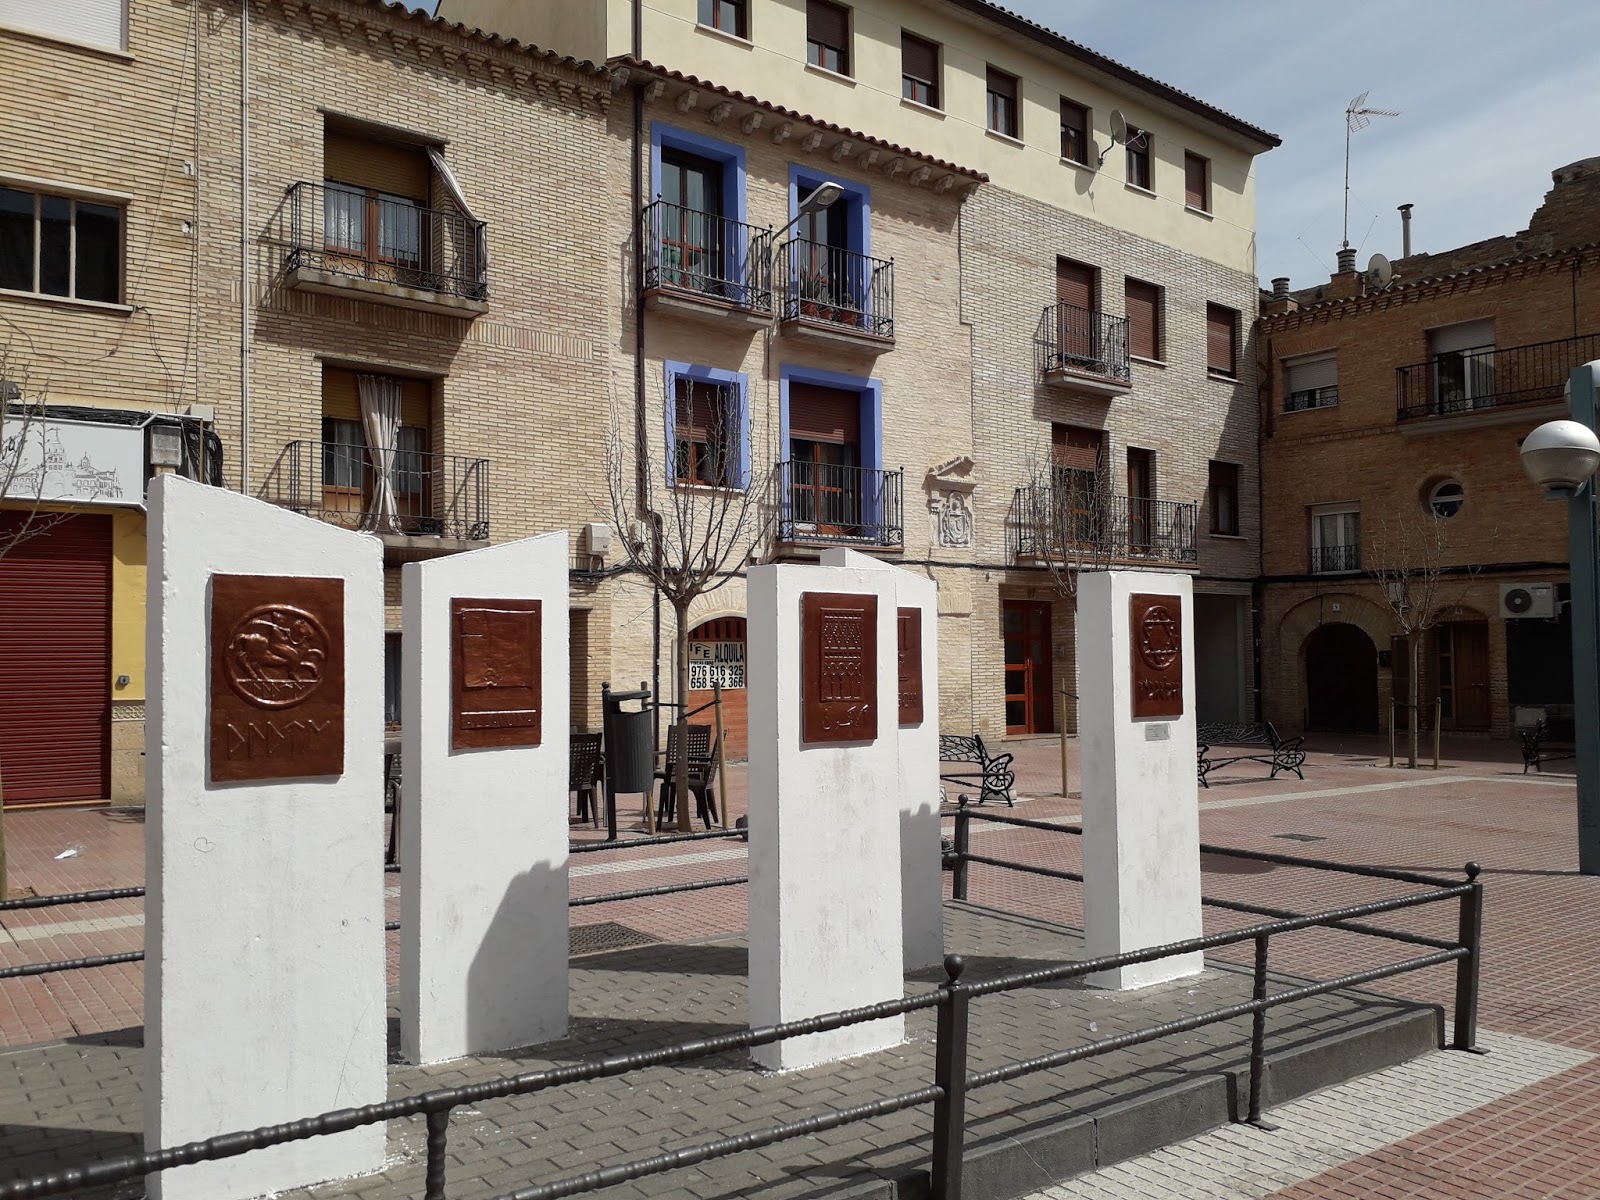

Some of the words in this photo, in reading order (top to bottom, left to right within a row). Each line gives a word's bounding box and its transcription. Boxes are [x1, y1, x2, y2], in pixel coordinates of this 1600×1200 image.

[715, 643, 744, 664] ALQUILA
[691, 666, 706, 677] 976
[710, 666, 725, 677] 616
[729, 665, 743, 676] 325
[691, 678, 706, 688] 658
[729, 677, 743, 688] 366
